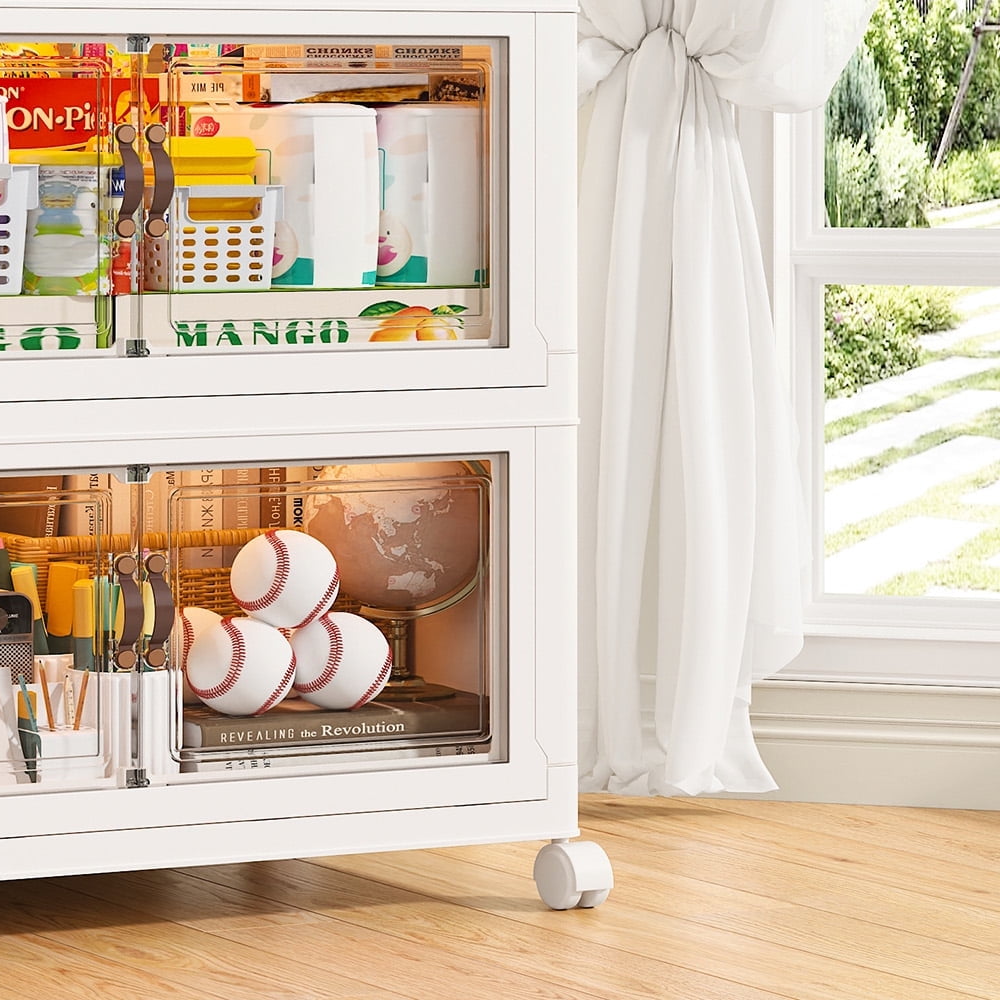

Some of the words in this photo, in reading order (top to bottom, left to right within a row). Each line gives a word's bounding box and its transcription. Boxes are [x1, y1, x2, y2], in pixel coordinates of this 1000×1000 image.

[174, 319, 350, 347] MANGO
[220, 728, 295, 744] REVEALING
[300, 729, 318, 738] the
[321, 721, 405, 737] Revolution
